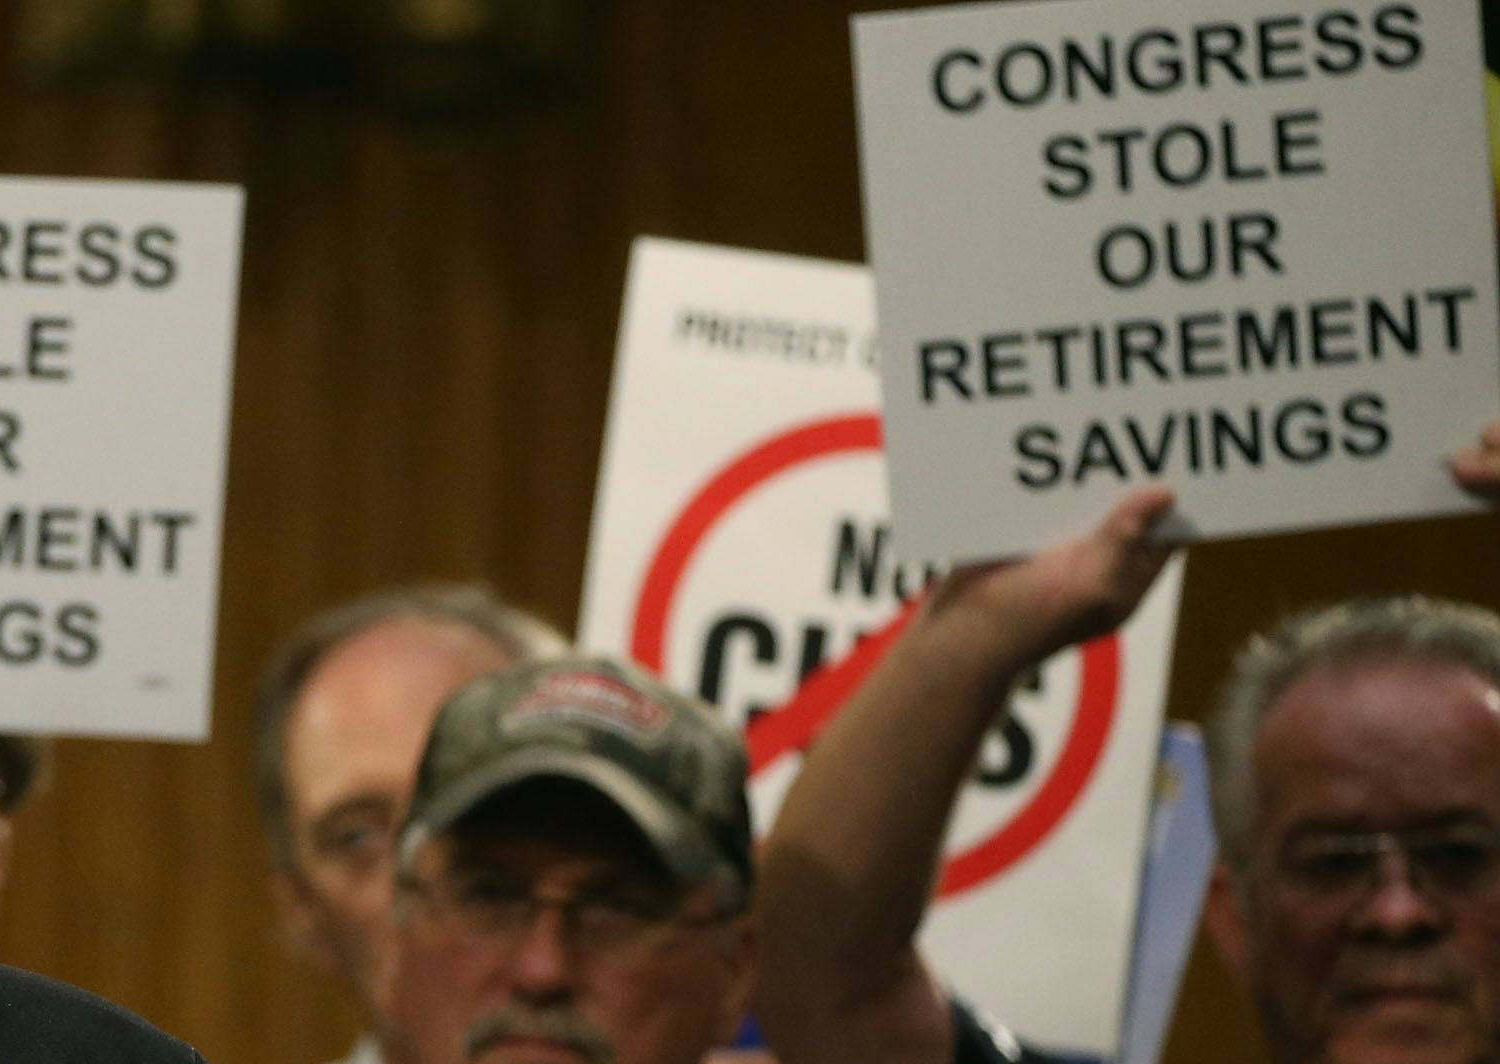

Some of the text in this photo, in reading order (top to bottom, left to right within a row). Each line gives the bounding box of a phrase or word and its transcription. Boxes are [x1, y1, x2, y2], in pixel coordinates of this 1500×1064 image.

[930, 3, 1425, 115] CONGRESS
[1041, 109, 1327, 201] STOLE
[1094, 211, 1285, 291] OUR
[917, 284, 1478, 407] RETIREMENT
[1012, 391, 1393, 490] SAVINGS
